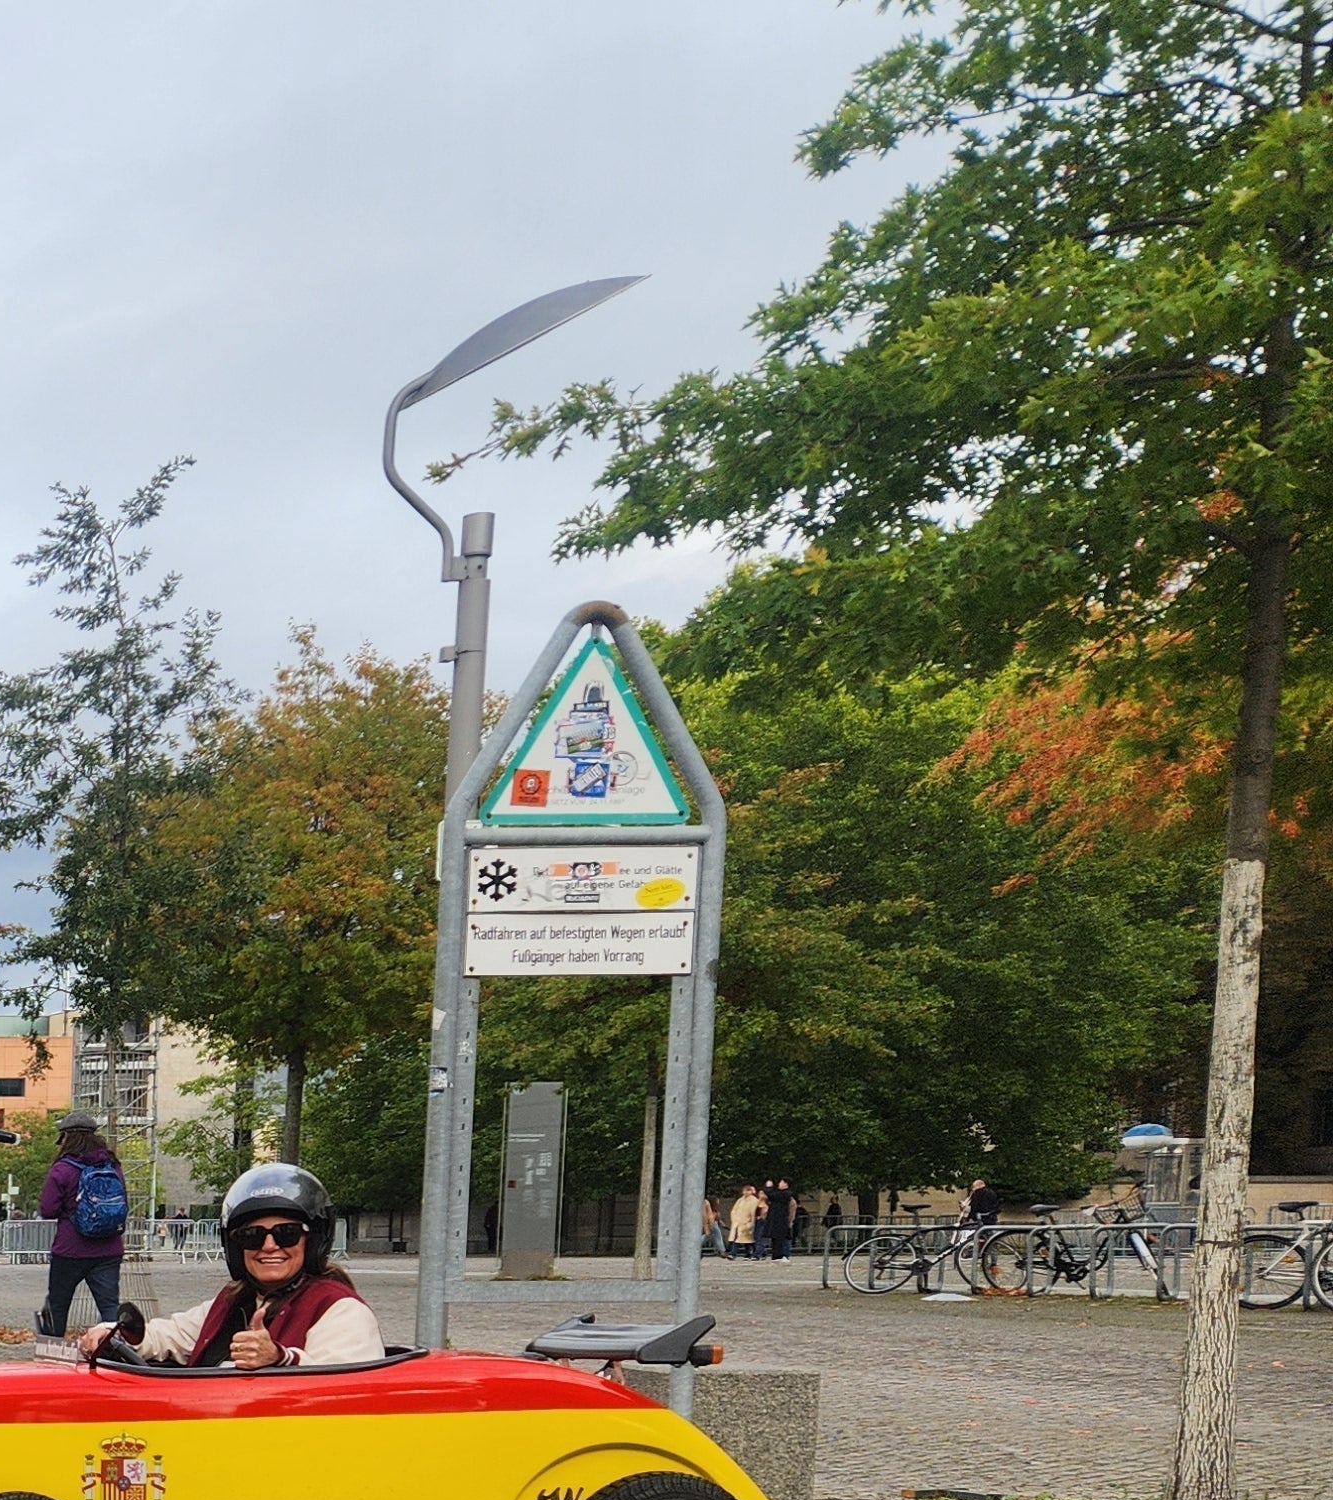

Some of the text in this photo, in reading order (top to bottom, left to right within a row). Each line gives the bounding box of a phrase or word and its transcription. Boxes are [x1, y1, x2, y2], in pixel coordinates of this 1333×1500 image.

[634, 866, 652, 875] und
[474, 925, 686, 943] Radfahren auf befestigten Wegen erlaubt
[512, 949, 644, 966] Fußgänger haben Vorrang
